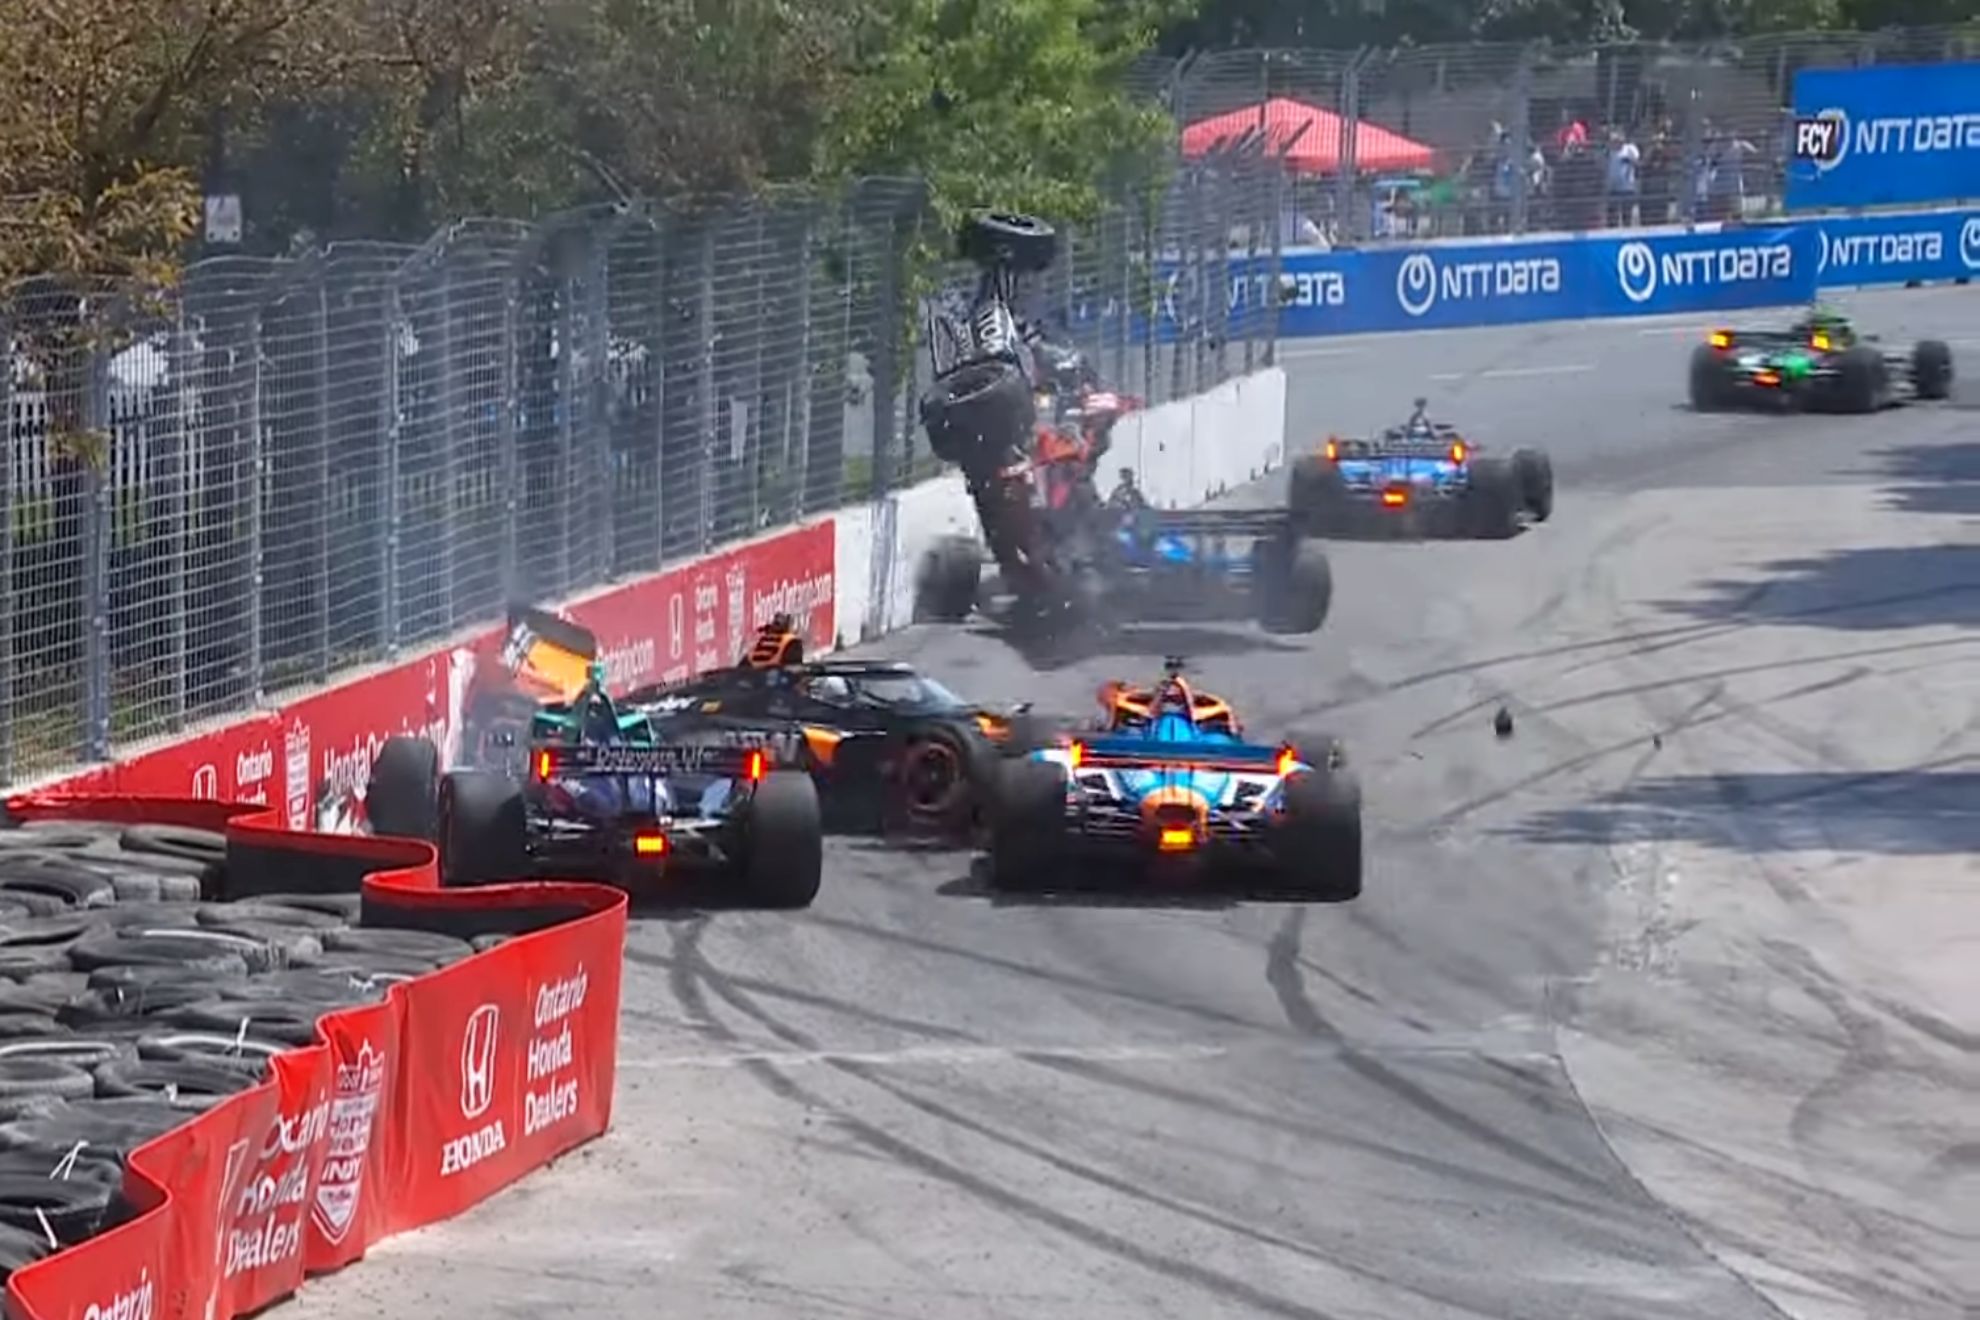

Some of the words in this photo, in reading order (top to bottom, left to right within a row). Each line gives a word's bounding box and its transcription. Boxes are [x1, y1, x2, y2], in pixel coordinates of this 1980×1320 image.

[1797, 122, 1832, 155] FCY
[1855, 117, 1912, 154] NTT
[1662, 247, 1717, 285] NTT
[1832, 234, 1880, 266] NTT
[1441, 262, 1494, 300] NTT
[534, 961, 588, 1029] Ontario
[526, 1019, 573, 1082] Honda
[523, 1076, 579, 1136] Dealers
[440, 1119, 506, 1176] HONDA
